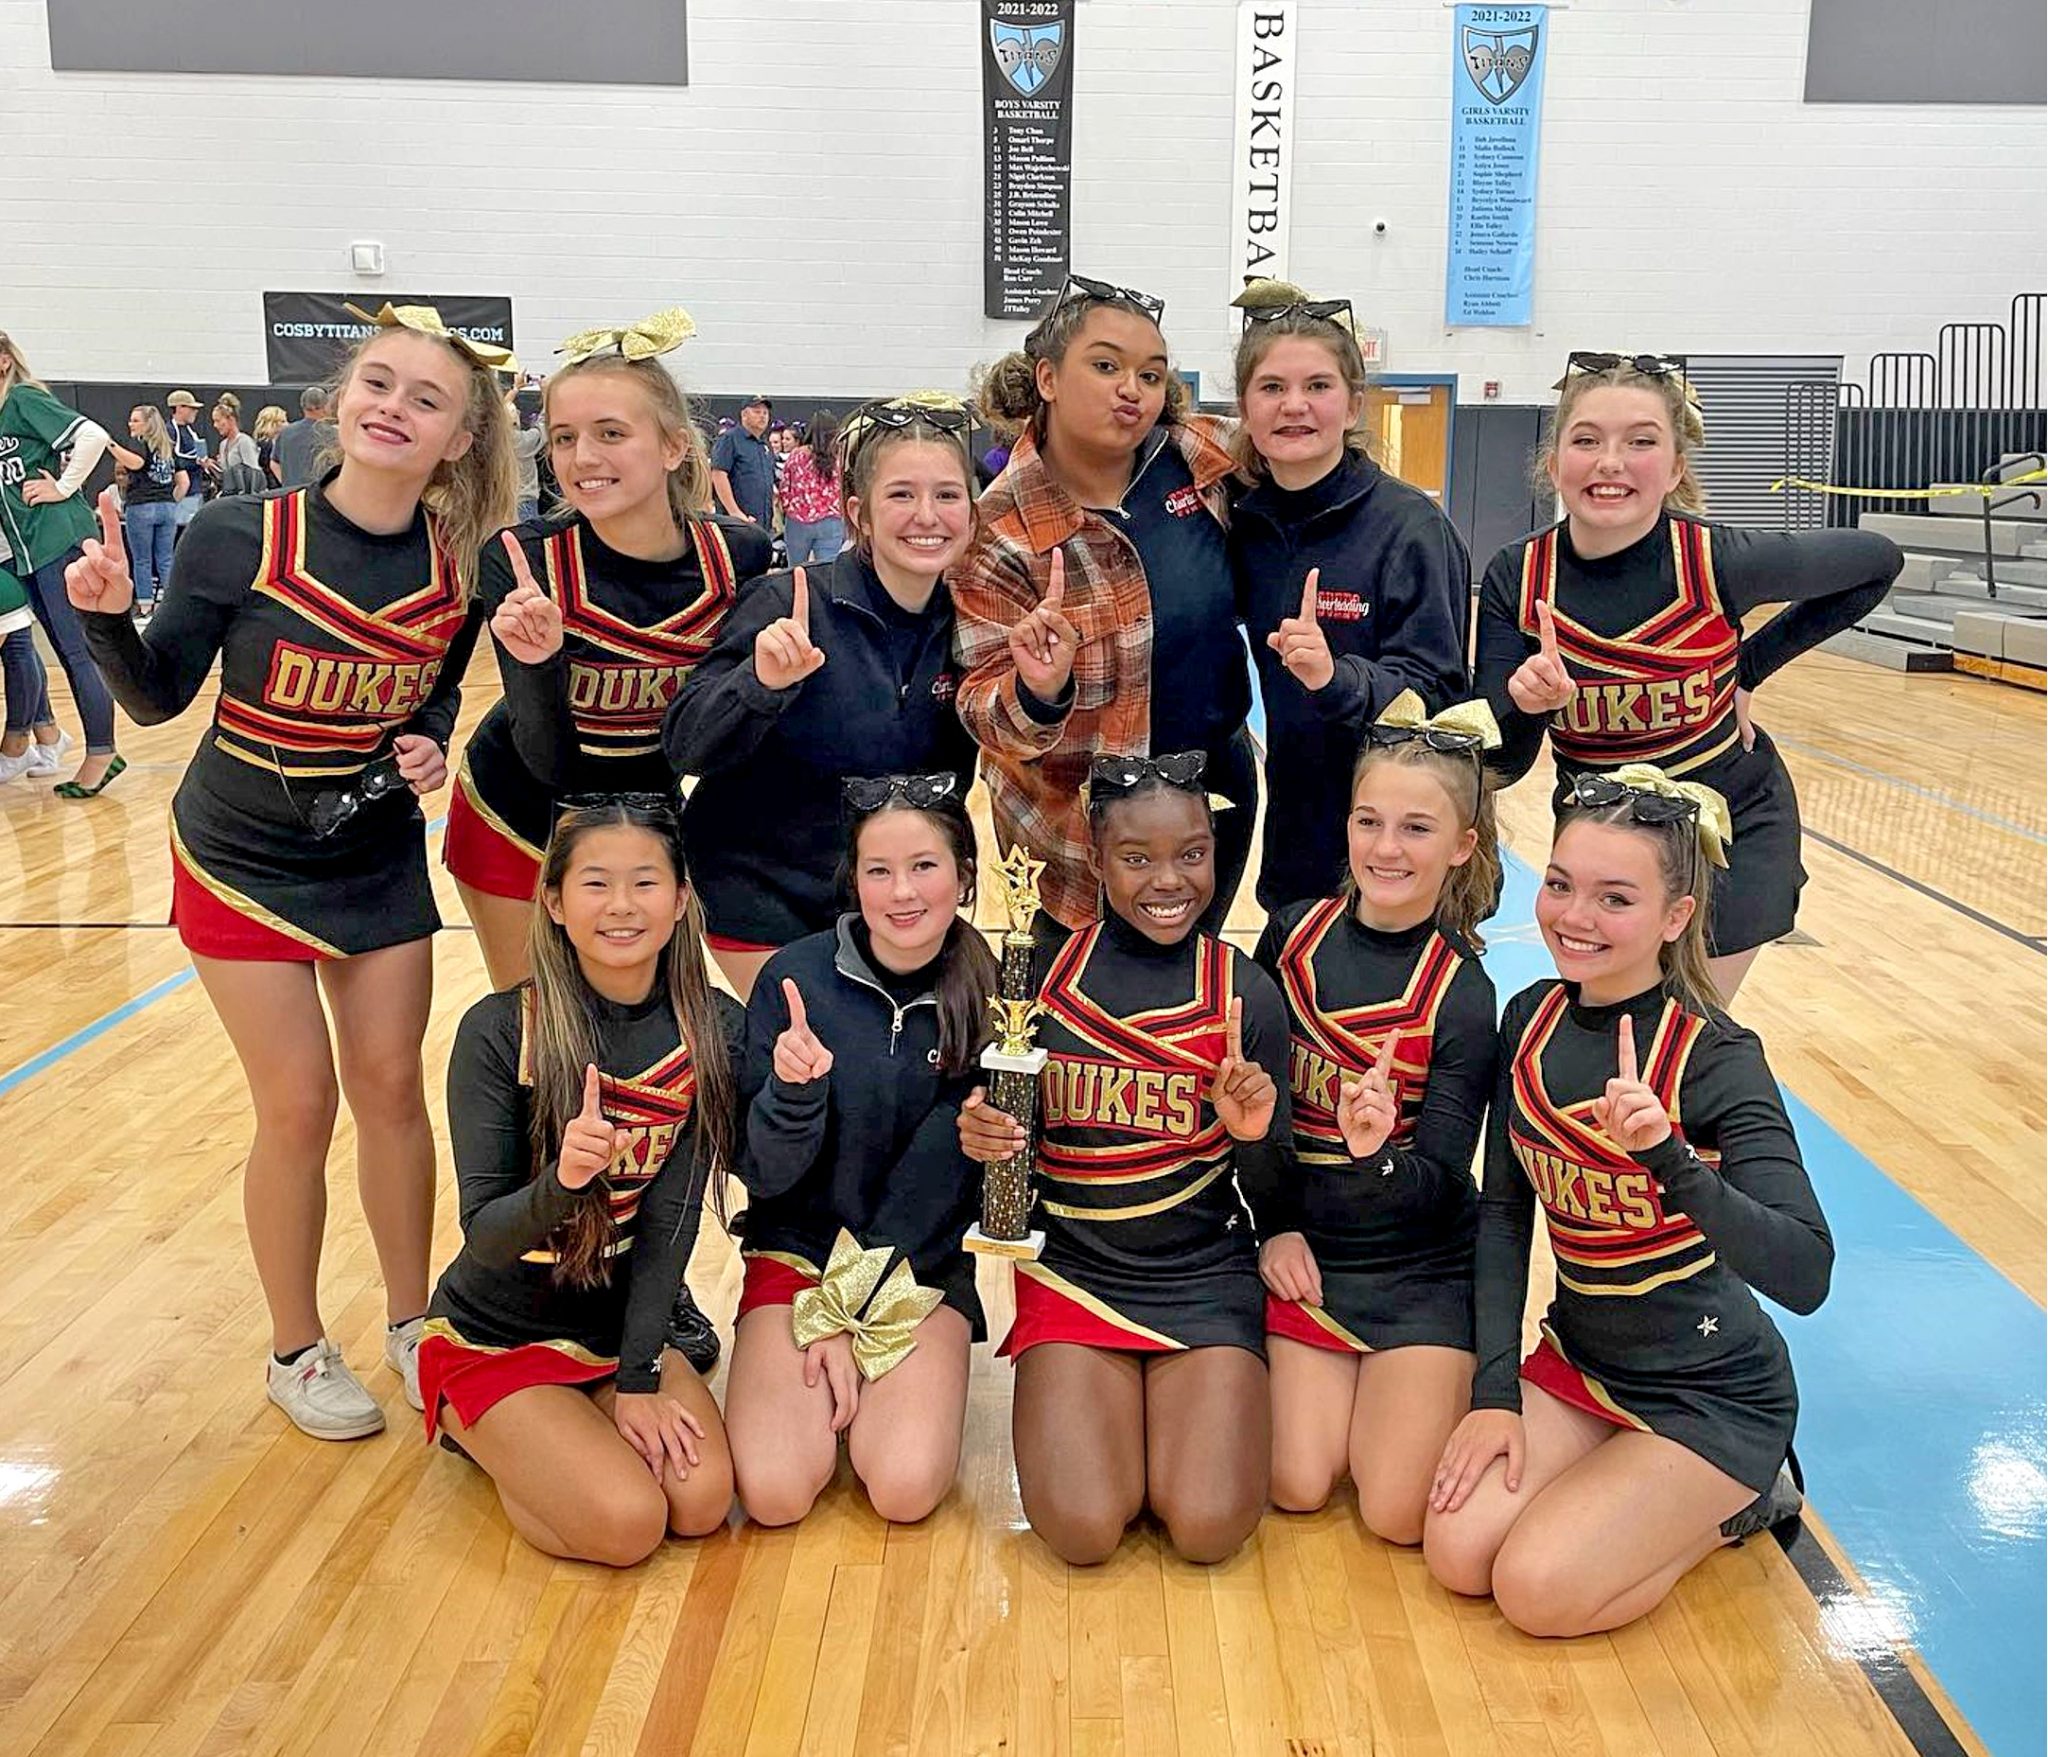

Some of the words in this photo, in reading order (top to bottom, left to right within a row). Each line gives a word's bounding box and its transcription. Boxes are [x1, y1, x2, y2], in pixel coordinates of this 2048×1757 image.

[997, 3, 1059, 16] 2021-2022
[1471, 10, 1531, 22] 2021-2022
[994, 99, 1020, 109] BOYS
[1021, 100, 1061, 110] VARSITY
[997, 110, 1059, 119] BASKETBALL
[1462, 107, 1490, 115] GIRLS
[1493, 107, 1530, 116] VARSITY
[1465, 117, 1525, 126] BASKETBALL
[1246, 10, 1284, 269] BASKETBA
[1555, 669, 1712, 733] UKES
